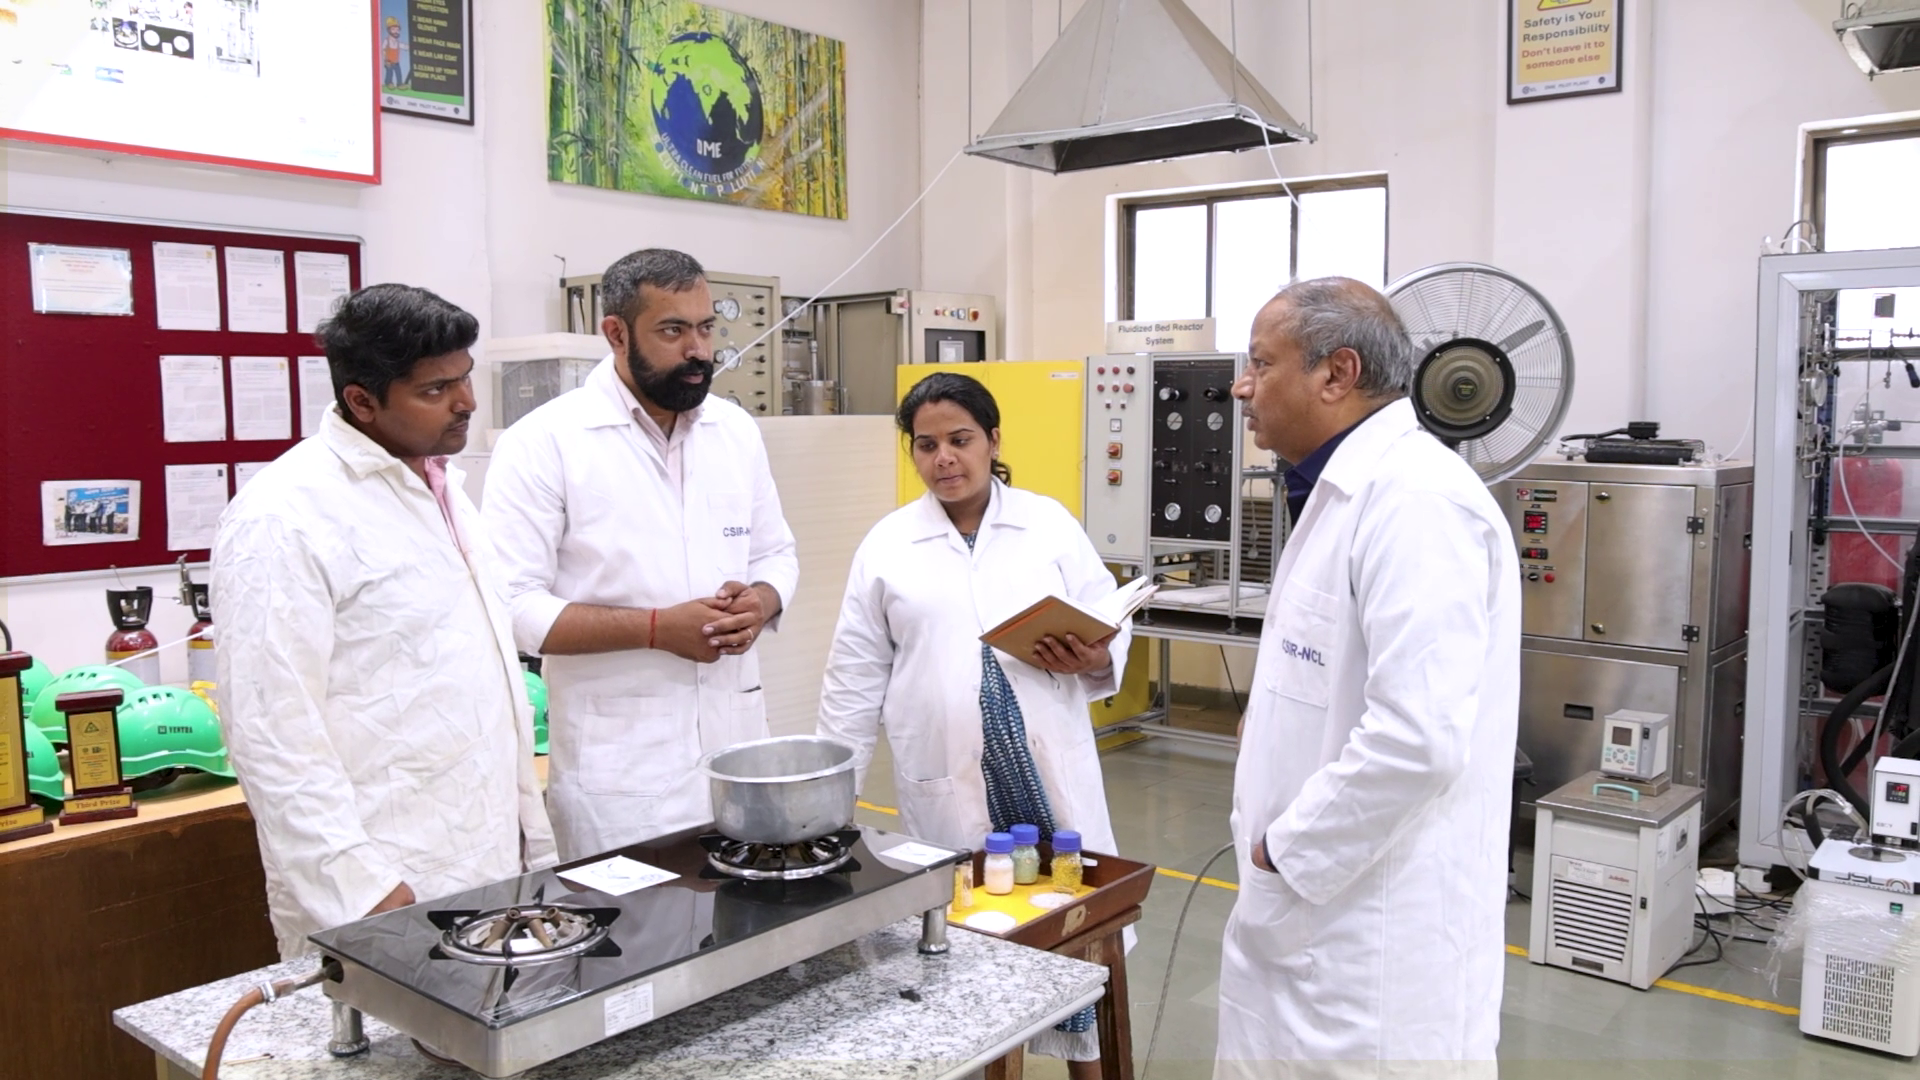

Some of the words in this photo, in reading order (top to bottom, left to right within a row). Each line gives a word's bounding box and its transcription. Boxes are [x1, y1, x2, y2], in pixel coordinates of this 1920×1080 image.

[1523, 16, 1562, 29] Safety
[1564, 13, 1575, 23] is
[1578, 9, 1606, 21] Your
[1522, 23, 1610, 43] Responsibility
[1521, 46, 1551, 58] Don't
[1553, 44, 1581, 55] leave
[1584, 42, 1591, 50] it
[1594, 40, 1605, 49] to
[1525, 57, 1575, 70] someone
[1577, 53, 1601, 63] else
[696, 138, 723, 158] DME
[661, 132, 682, 163] ULTRA
[680, 159, 703, 181] CLEAN
[704, 174, 722, 184] FUEL
[722, 170, 735, 182] FOR
[1118, 325, 1153, 333] Fluidized
[1155, 323, 1170, 332] Bed
[1172, 323, 1204, 331] Reactor
[1145, 337, 1174, 346] System
[75, 801, 98, 809] Third
[100, 798, 121, 806] Prize
[1834, 871, 1885, 886] JSL
